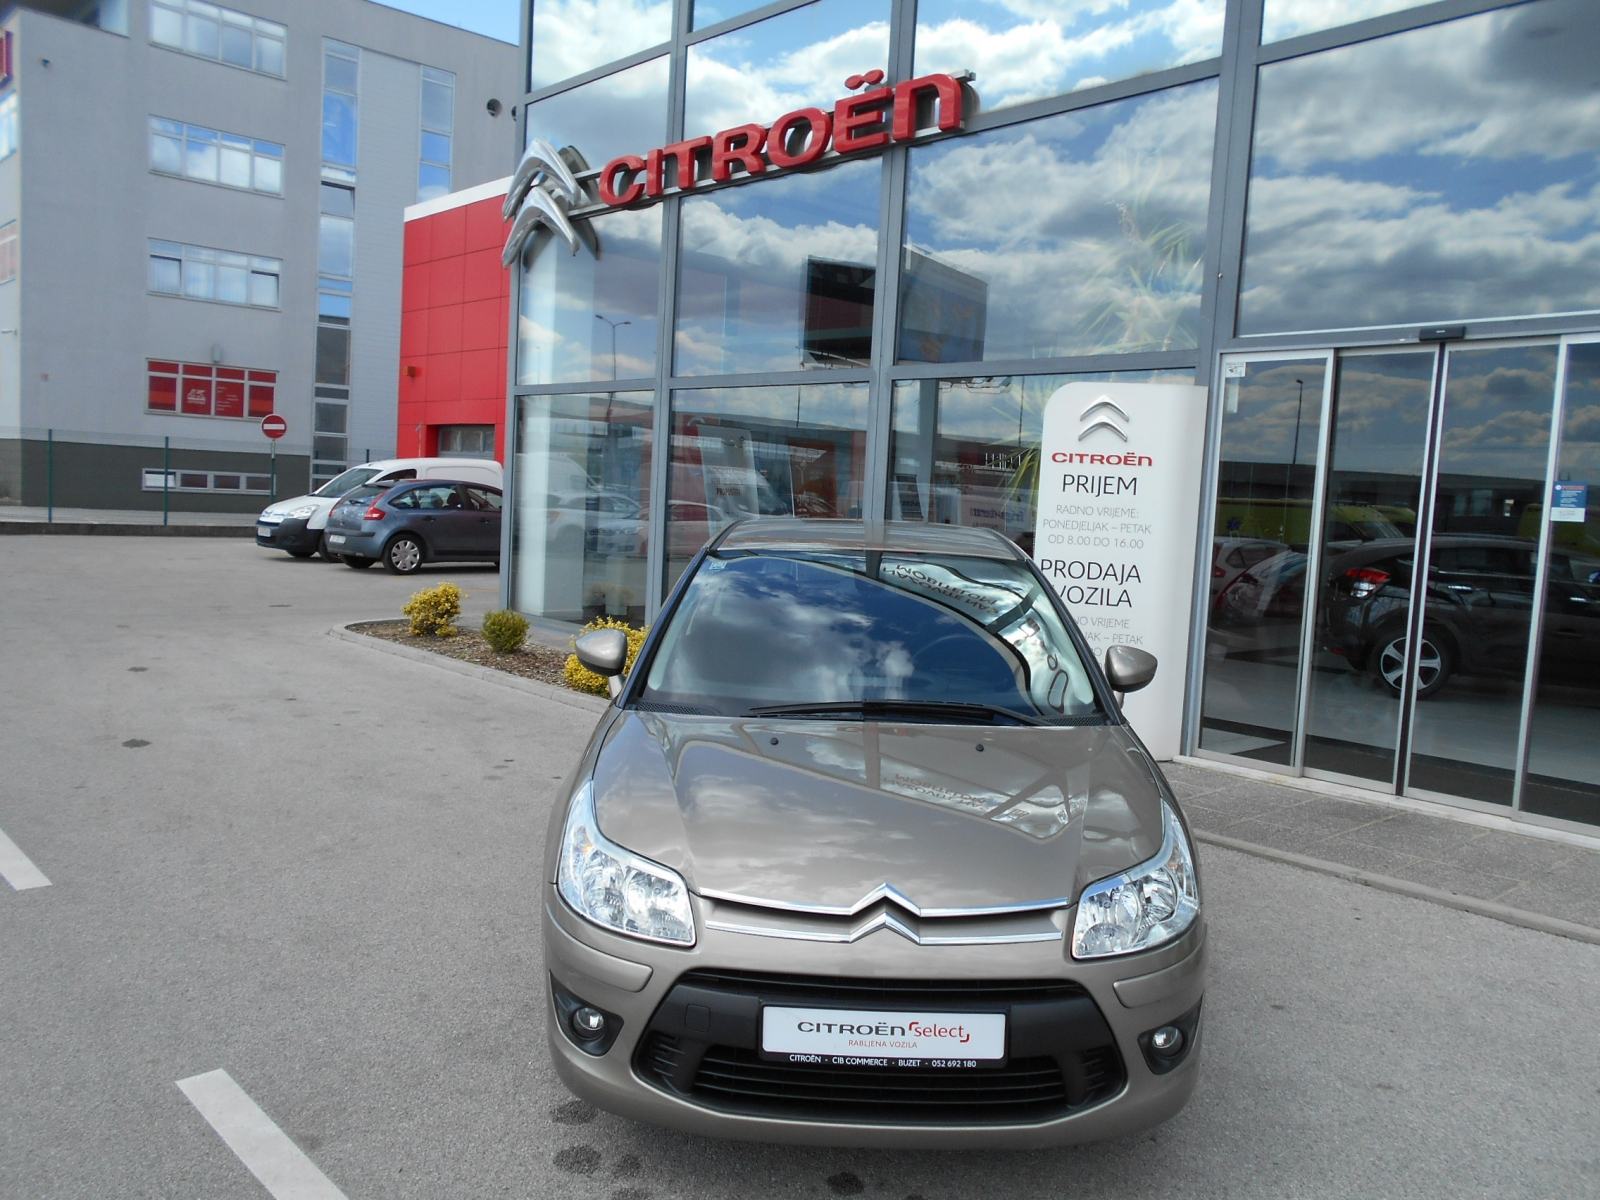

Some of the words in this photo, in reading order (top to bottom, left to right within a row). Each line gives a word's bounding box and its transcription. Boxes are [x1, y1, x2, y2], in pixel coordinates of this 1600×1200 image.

[1062, 474, 1137, 497] PRIJEM
[1056, 504, 1094, 516] RADNO
[1042, 519, 1109, 533] PONEDJELJAK
[1120, 523, 1152, 535] PETAK
[1048, 534, 1065, 544] OD
[1067, 535, 1091, 546] 8.00
[1093, 537, 1110, 547] DO
[1114, 538, 1144, 549] 16.00
[1040, 559, 1142, 586] PRODAJA
[1112, 634, 1144, 645] PETAK
[848, 1039, 887, 1048] RABLJENA
[889, 1041, 918, 1049] VOZILA
[832, 1056, 844, 1064] CIB
[845, 1057, 888, 1067] COMMERCE
[898, 1059, 921, 1067] BUZET
[963, 1060, 977, 1068] 180
